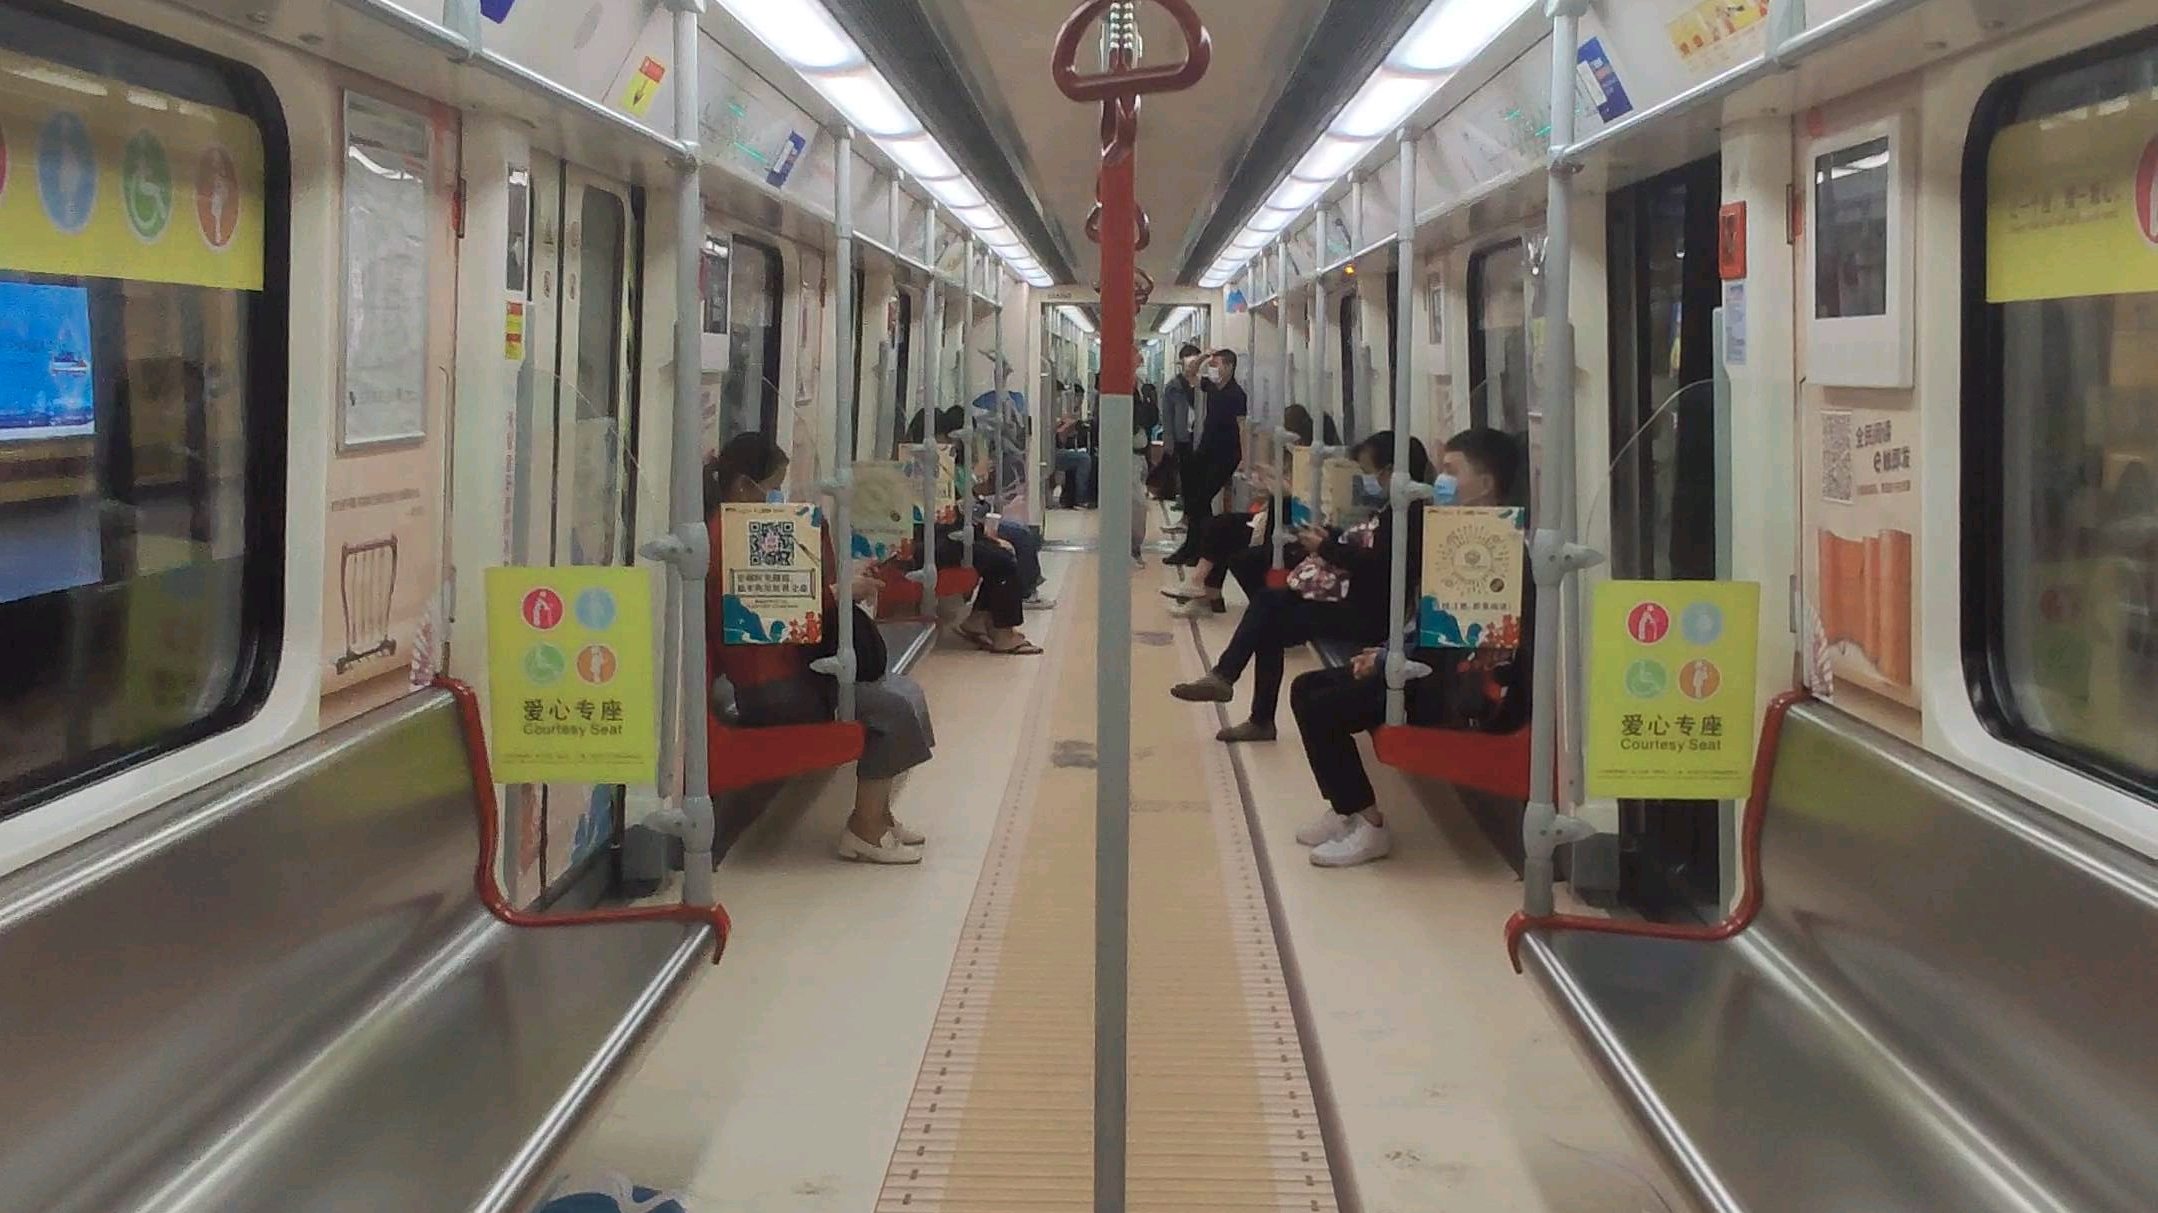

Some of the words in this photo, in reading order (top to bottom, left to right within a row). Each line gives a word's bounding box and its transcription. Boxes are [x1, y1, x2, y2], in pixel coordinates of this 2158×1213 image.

[523, 698, 623, 721] 爱心专座
[523, 723, 585, 736] Courtesy
[590, 723, 622, 735] Seat
[1621, 714, 1722, 736] 爱心专座
[1620, 738, 1685, 753] Courtesy
[1689, 738, 1721, 750] Seat
